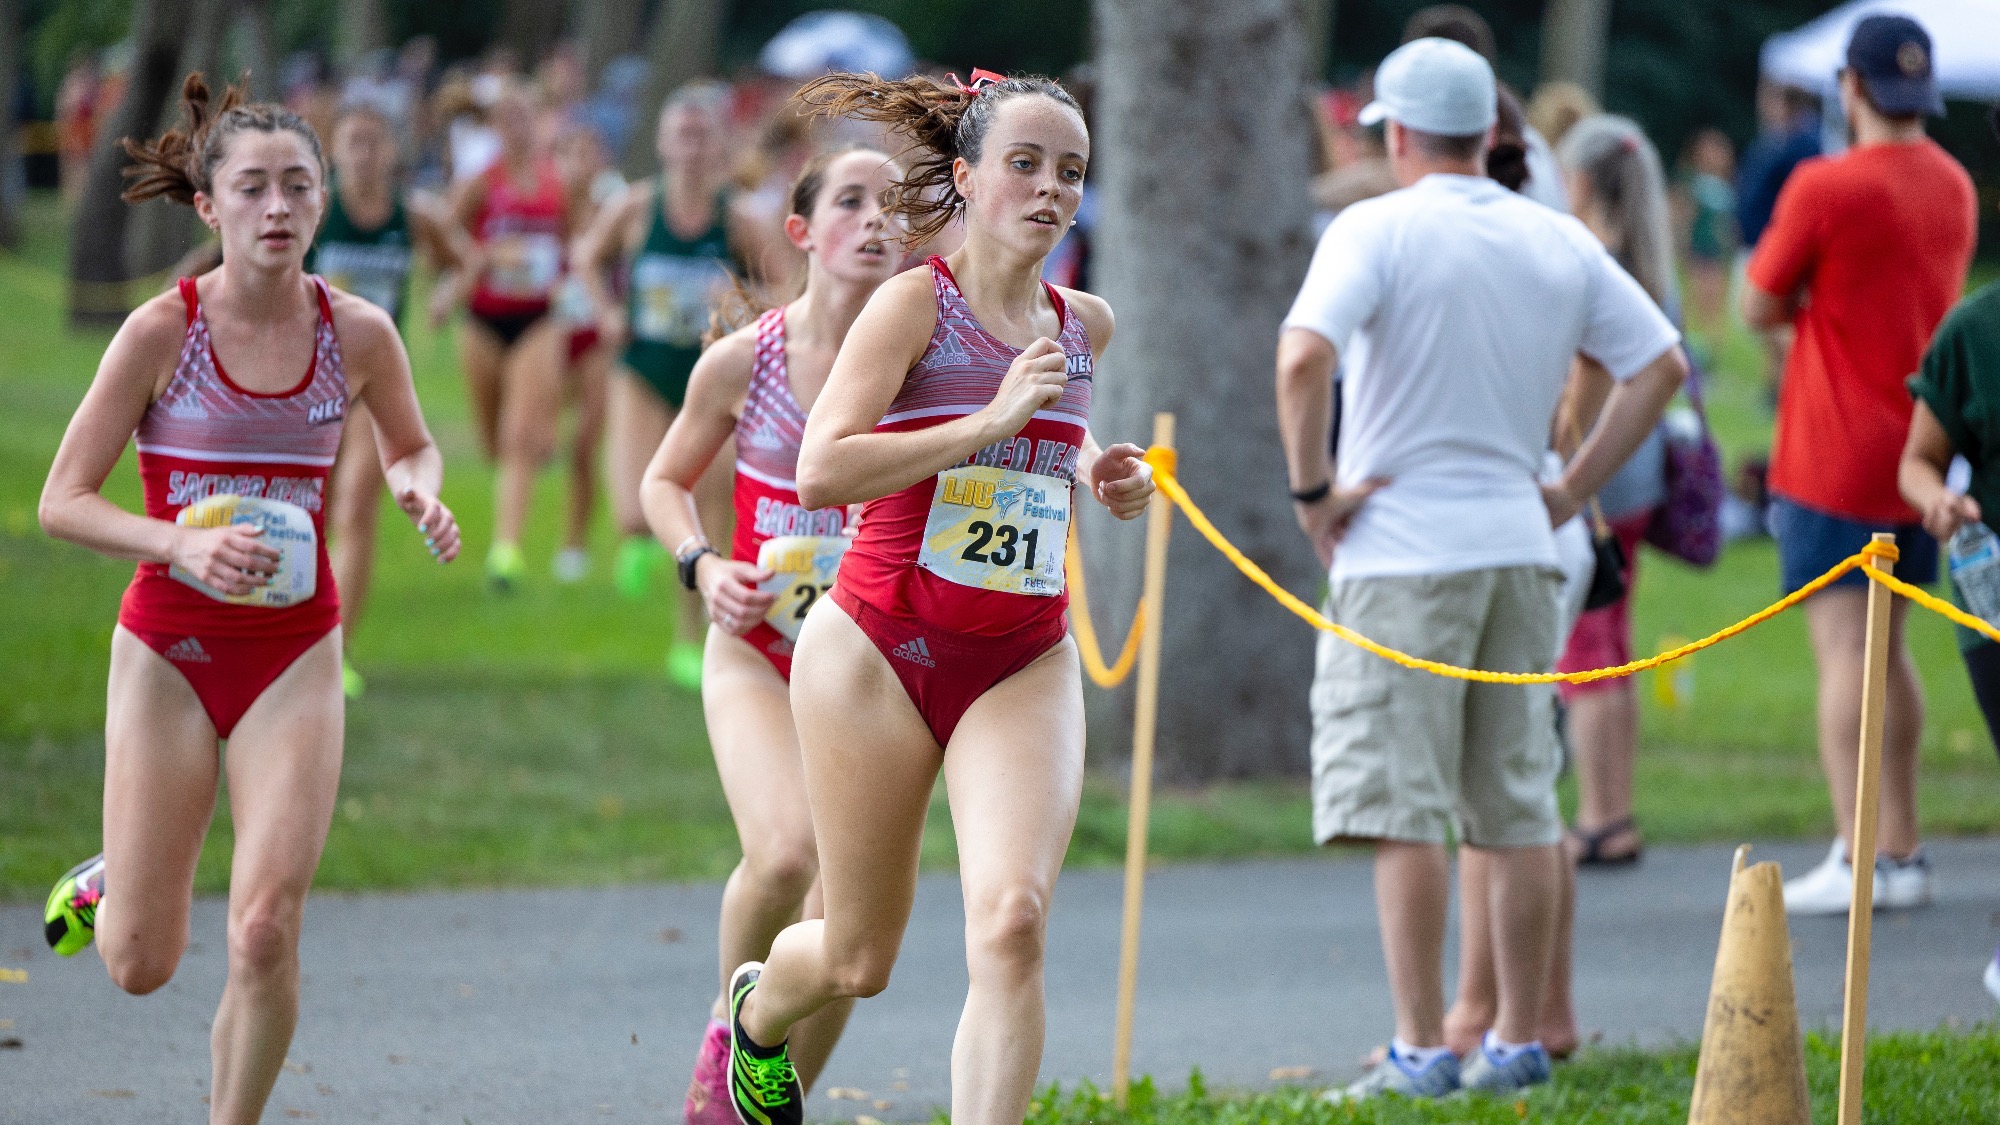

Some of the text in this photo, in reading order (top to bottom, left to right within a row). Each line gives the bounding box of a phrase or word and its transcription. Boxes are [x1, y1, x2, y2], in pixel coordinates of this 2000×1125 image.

[926, 352, 971, 370] adidas
[942, 476, 996, 509] LIU
[1024, 487, 1046, 503] Fall
[753, 496, 844, 537] SACRED
[1022, 502, 1066, 522] Festival
[960, 520, 1039, 571] 231
[1024, 577, 1047, 589] FUEL
[892, 647, 936, 668] adidas
